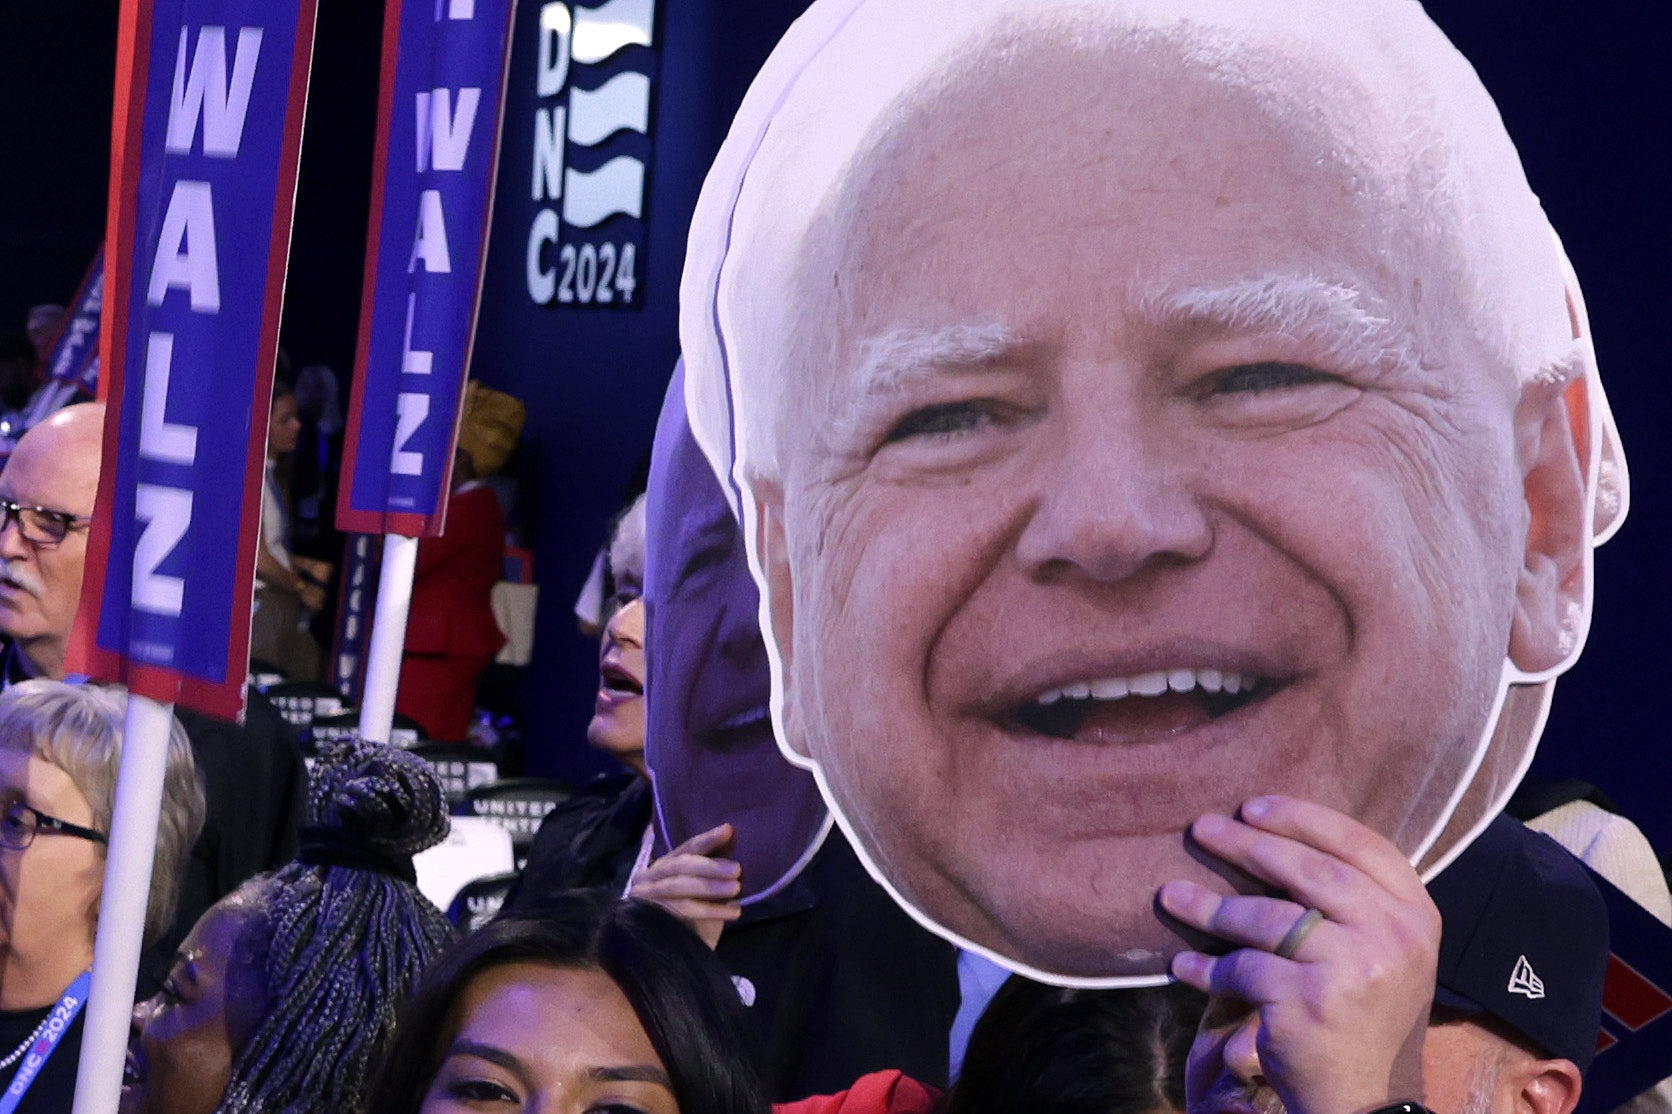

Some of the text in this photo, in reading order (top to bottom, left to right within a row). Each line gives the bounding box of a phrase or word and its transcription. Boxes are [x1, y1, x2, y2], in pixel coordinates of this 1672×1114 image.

[389, 87, 482, 476] WALZ
[527, 0, 572, 304] DNC
[558, 242, 636, 304] 2024
[130, 24, 265, 618] WALZ
[10, 994, 78, 1096] DNC 2024
